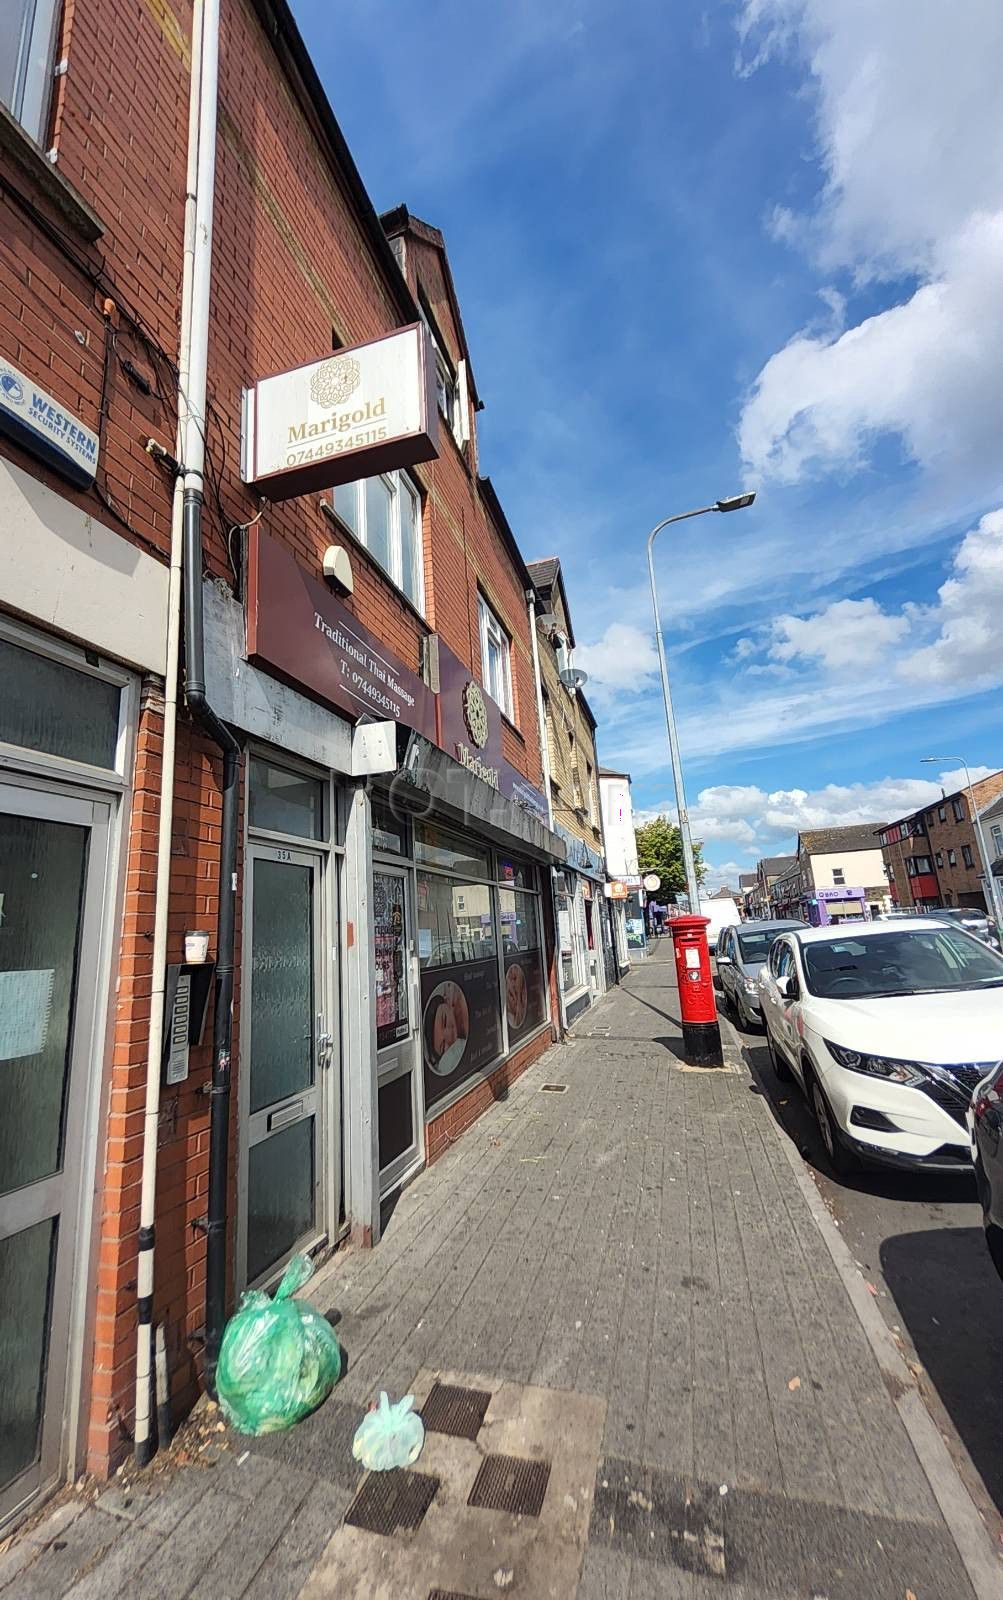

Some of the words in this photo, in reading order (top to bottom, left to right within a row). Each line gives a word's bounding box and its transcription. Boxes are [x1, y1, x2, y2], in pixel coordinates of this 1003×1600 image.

[28, 407, 66, 439] SECURITY
[66, 436, 96, 465] SYSTEMS
[32, 392, 97, 454] WESTERN
[286, 426, 388, 466] 07449345115
[287, 396, 387, 444] Marigold
[314, 611, 367, 668] Traditional
[368, 658, 386, 684] Thai
[387, 674, 415, 707] Massage
[352, 672, 401, 718] 07449345115
